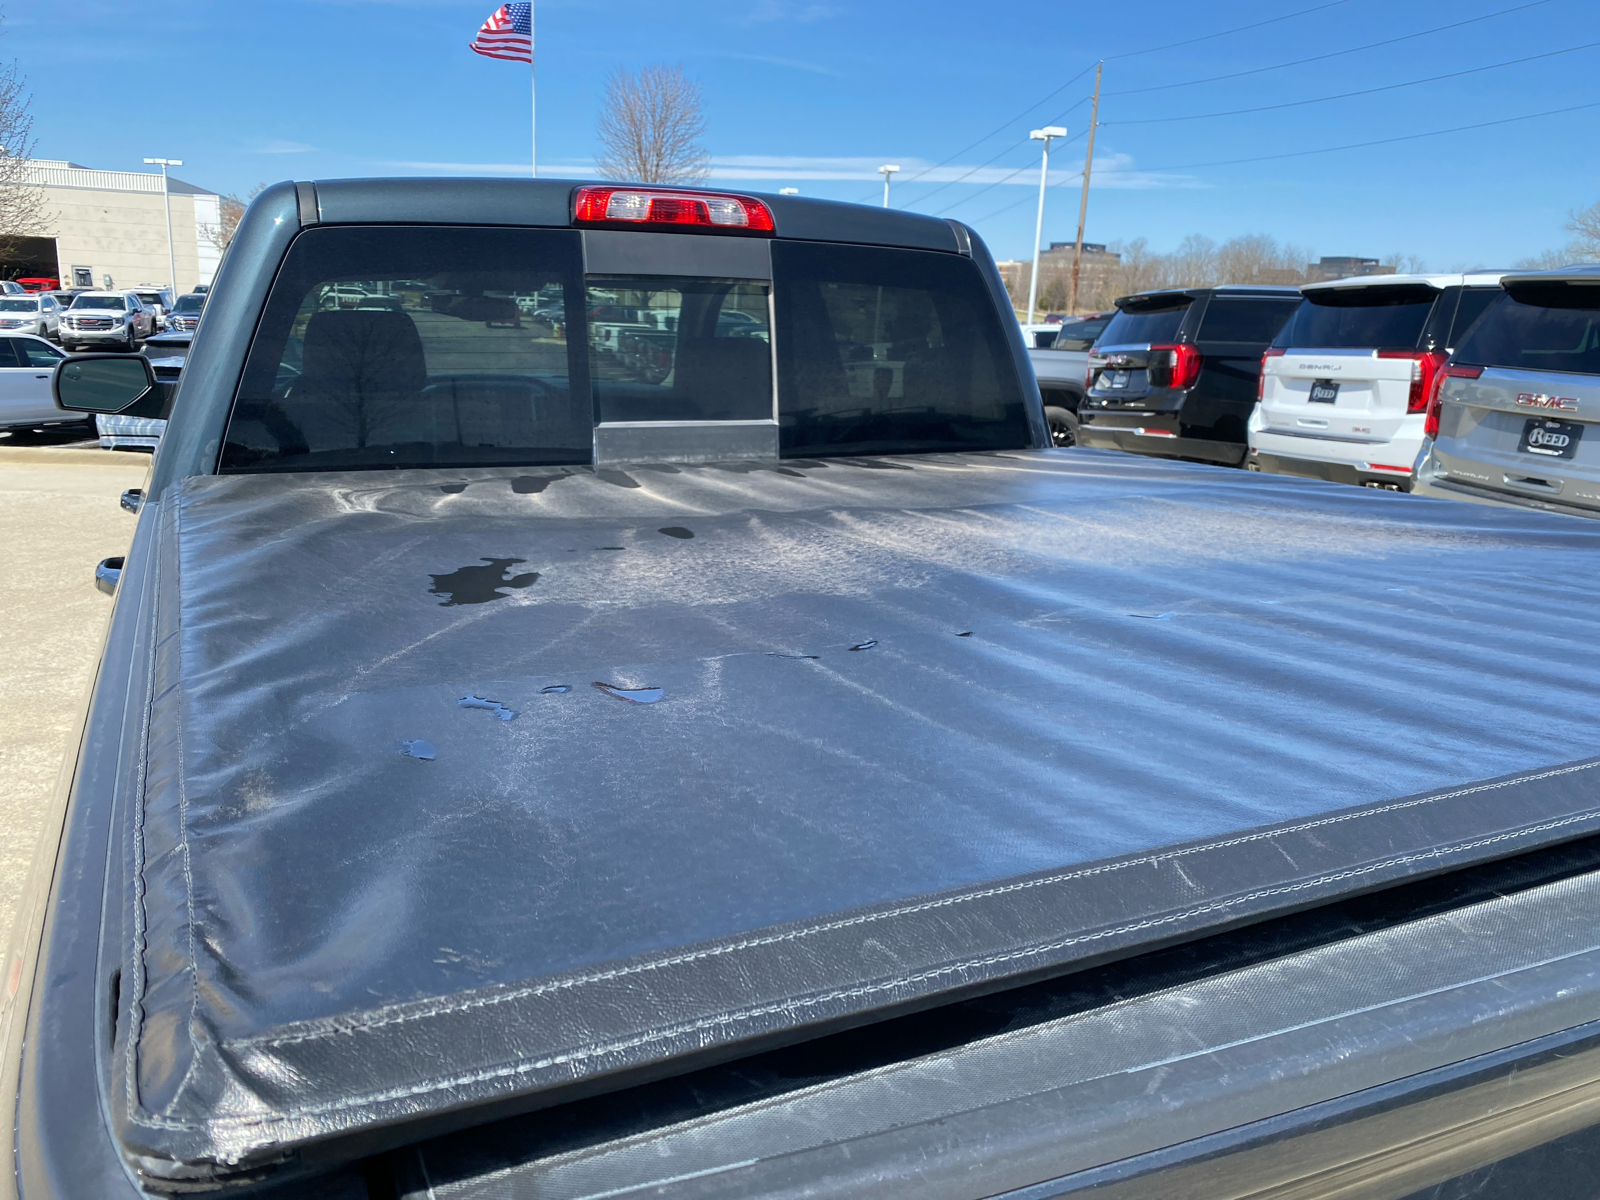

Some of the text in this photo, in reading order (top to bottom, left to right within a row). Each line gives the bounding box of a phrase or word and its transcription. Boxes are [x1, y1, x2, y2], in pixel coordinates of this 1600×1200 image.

[1312, 386, 1335, 400] REED
[1516, 393, 1580, 412] GMC
[1528, 428, 1570, 447] REED
